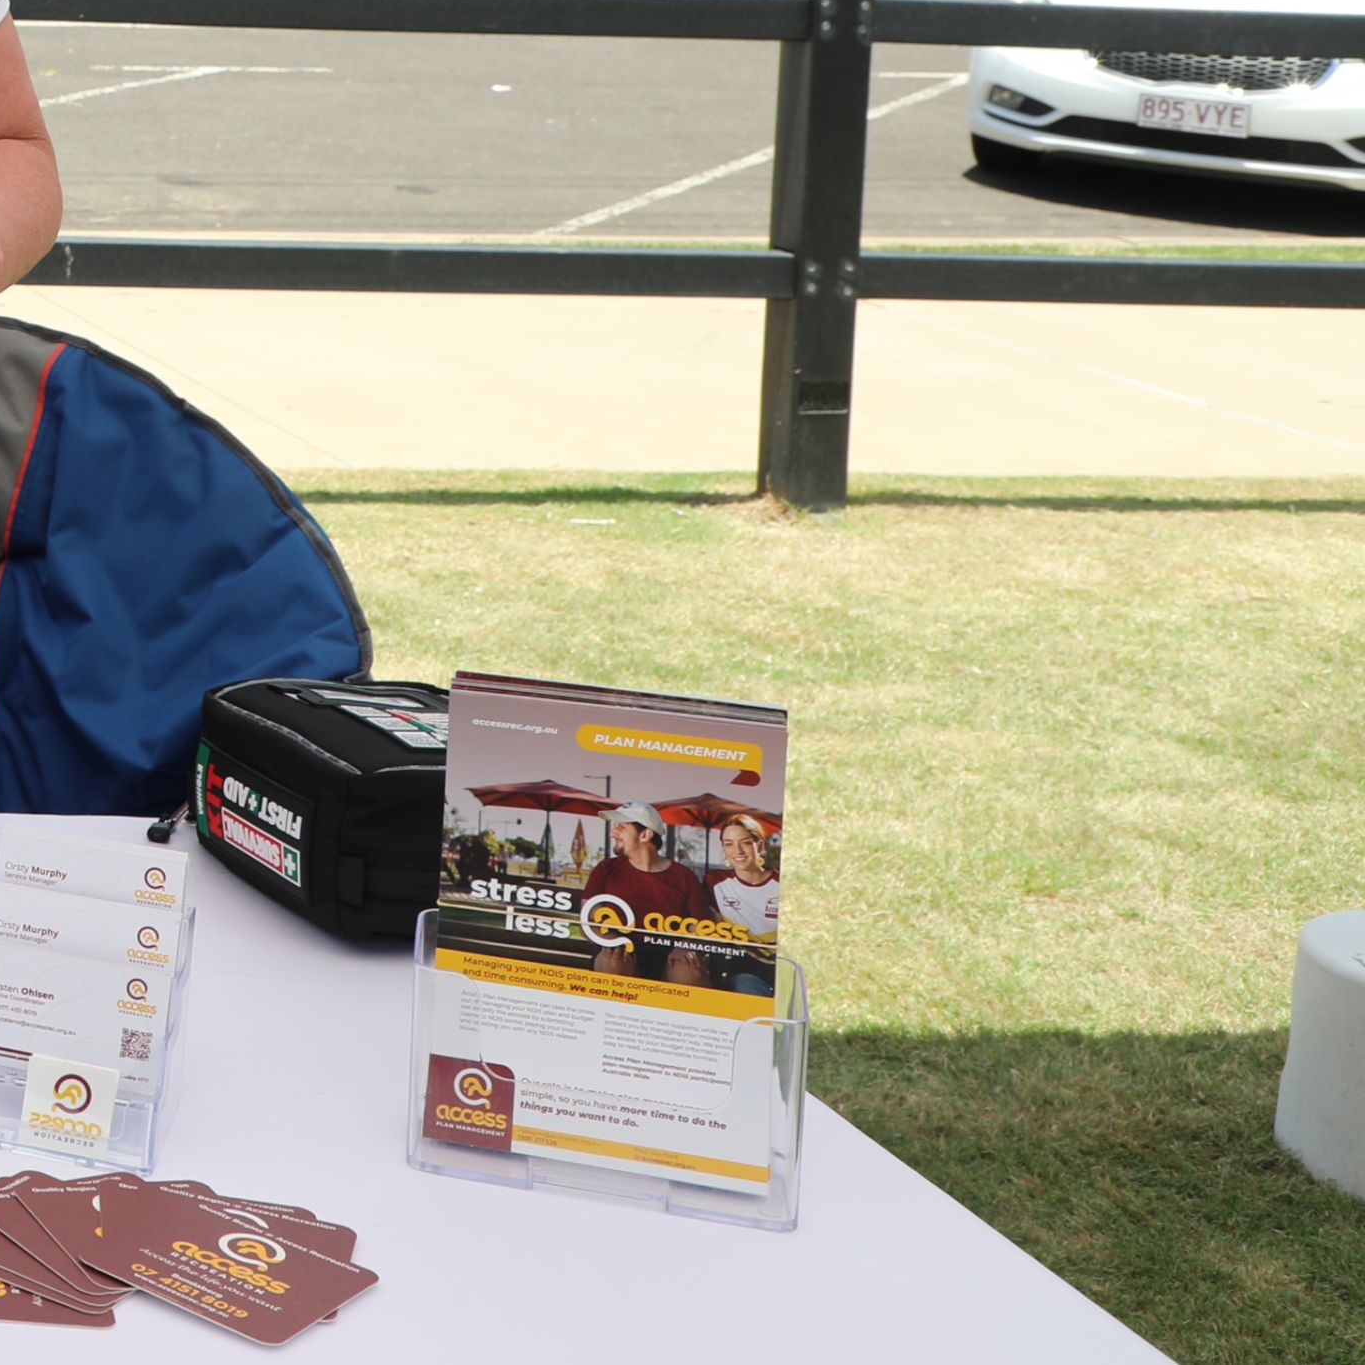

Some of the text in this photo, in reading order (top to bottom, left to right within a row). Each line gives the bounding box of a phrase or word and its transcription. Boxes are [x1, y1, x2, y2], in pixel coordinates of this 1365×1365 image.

[472, 717, 559, 735] accessrec.org.au
[593, 733, 748, 762] PLAN MANAGEMENT
[222, 776, 303, 840] FIRST AID
[223, 809, 281, 868] SURVIVAL
[5, 861, 68, 881] Cirsty Murphy
[134, 889, 177, 905] access
[470, 878, 573, 911] stress
[505, 905, 571, 939] less
[643, 912, 750, 943] access
[643, 936, 747, 957] PLAN MANAGEMENT
[462, 967, 482, 977] and
[484, 971, 507, 981] time
[569, 983, 586, 993] We
[589, 987, 609, 996] can
[611, 989, 639, 1002] help!
[463, 956, 690, 998] Managing your NDIS plan can be complicated
[21, 987, 55, 1001] Ohlsen
[117, 999, 158, 1016] access
[435, 1104, 508, 1130] access
[520, 1088, 728, 1131] simple, so you have more time to do the
[520, 1100, 640, 1128] things you want to do.
[435, 1121, 506, 1137] PLAN MANAGEMENT
[170, 1251, 266, 1296] RECREATION
[171, 1241, 293, 1295] access
[131, 1263, 250, 1320] 07 4151 8019
